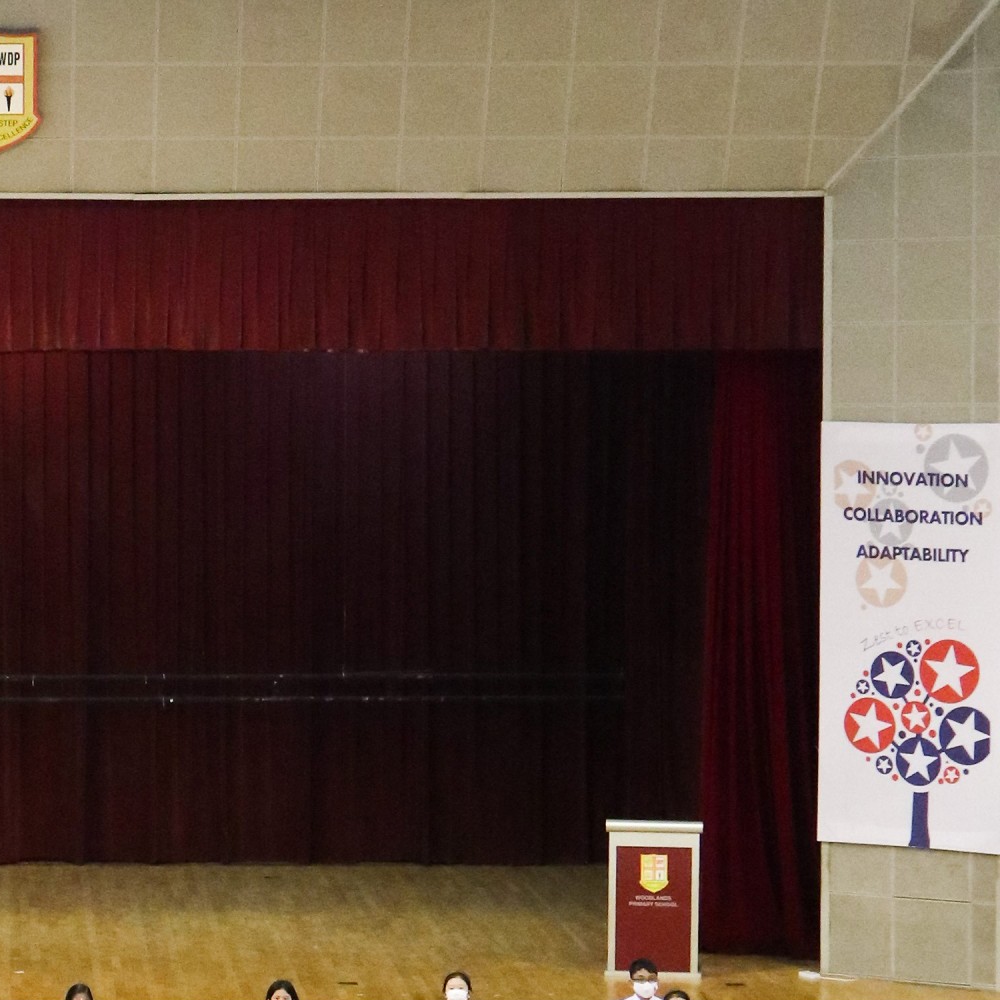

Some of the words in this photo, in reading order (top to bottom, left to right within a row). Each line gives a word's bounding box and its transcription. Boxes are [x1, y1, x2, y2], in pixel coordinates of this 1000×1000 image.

[857, 469, 969, 488] INNOVATION
[843, 507, 983, 526] COLLABORATION
[856, 544, 970, 563] ADAPTABILITY
[860, 630, 894, 652] Zest
[895, 625, 909, 637] to
[913, 617, 966, 633] EXCEL
